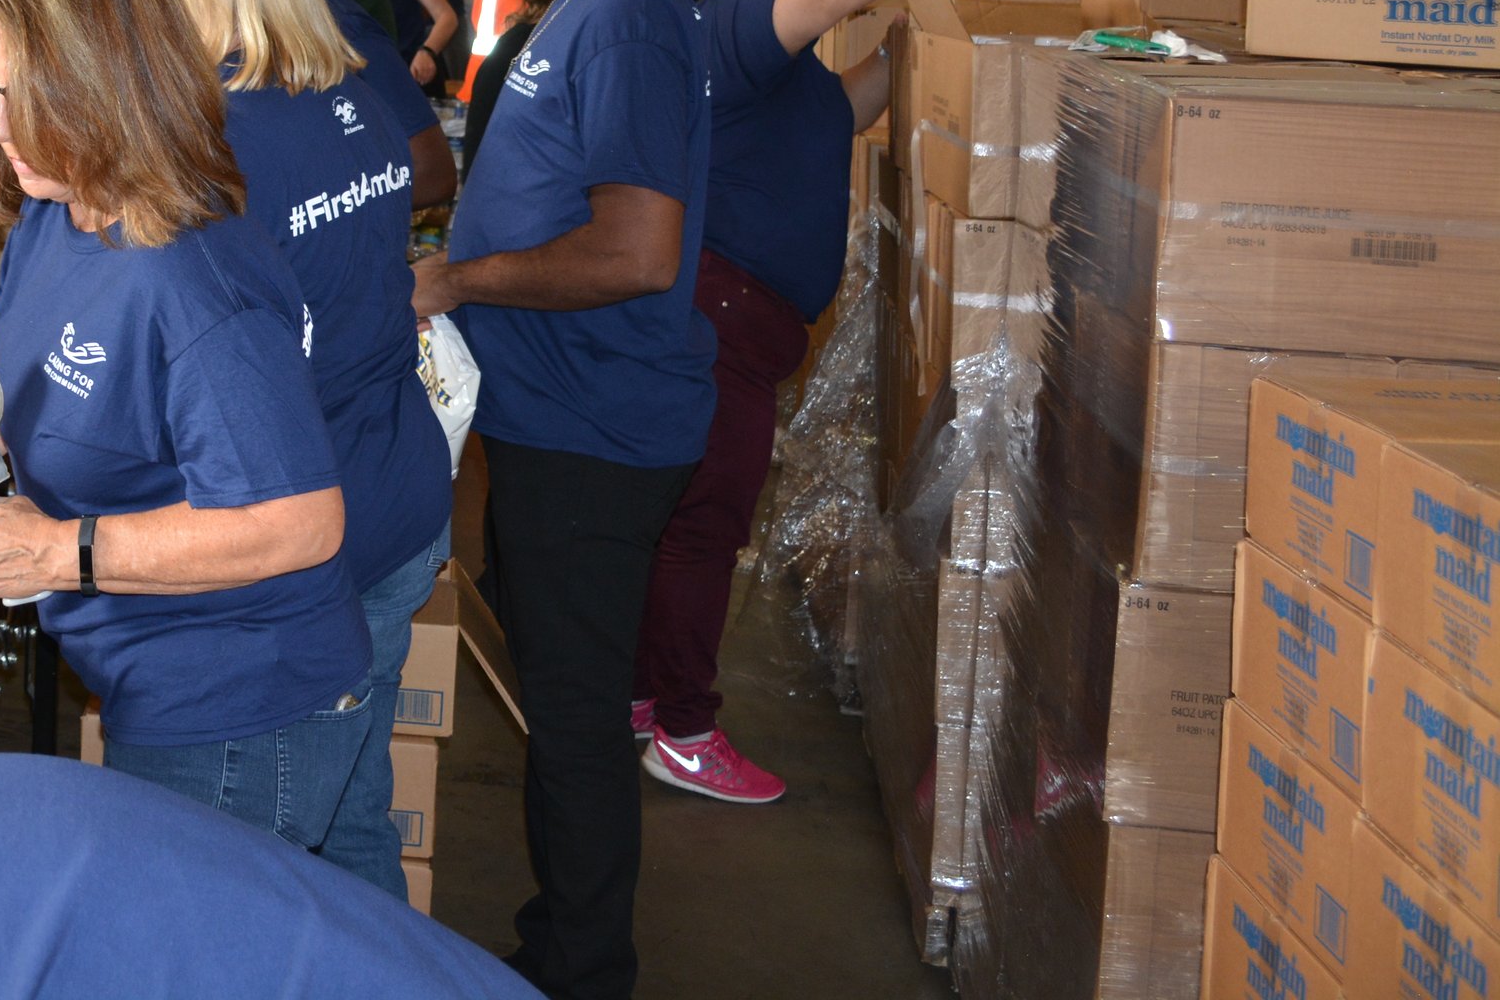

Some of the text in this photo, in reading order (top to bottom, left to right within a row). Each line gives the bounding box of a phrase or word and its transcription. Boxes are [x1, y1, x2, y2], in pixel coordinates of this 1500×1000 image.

[1380, 29, 1496, 45] Instant Nonfat Dry Milk
[1176, 104, 1221, 120] 8-64 oz
[1251, 202, 1285, 217] PATCH
[1287, 204, 1321, 219] APPLE
[1321, 206, 1353, 221] JUICE
[50, 370, 90, 400] COMMUNITY
[72, 370, 95, 391] FOR
[1291, 457, 1335, 508] maid
[1434, 543, 1493, 607] maid
[1156, 601, 1170, 611] oz
[1276, 625, 1318, 682] maid
[1170, 690, 1229, 706] FRUIT PATC
[1197, 708, 1218, 721] UPC
[1424, 747, 1483, 821] maid
[1263, 794, 1305, 857] maid
[1402, 937, 1460, 1000] maid
